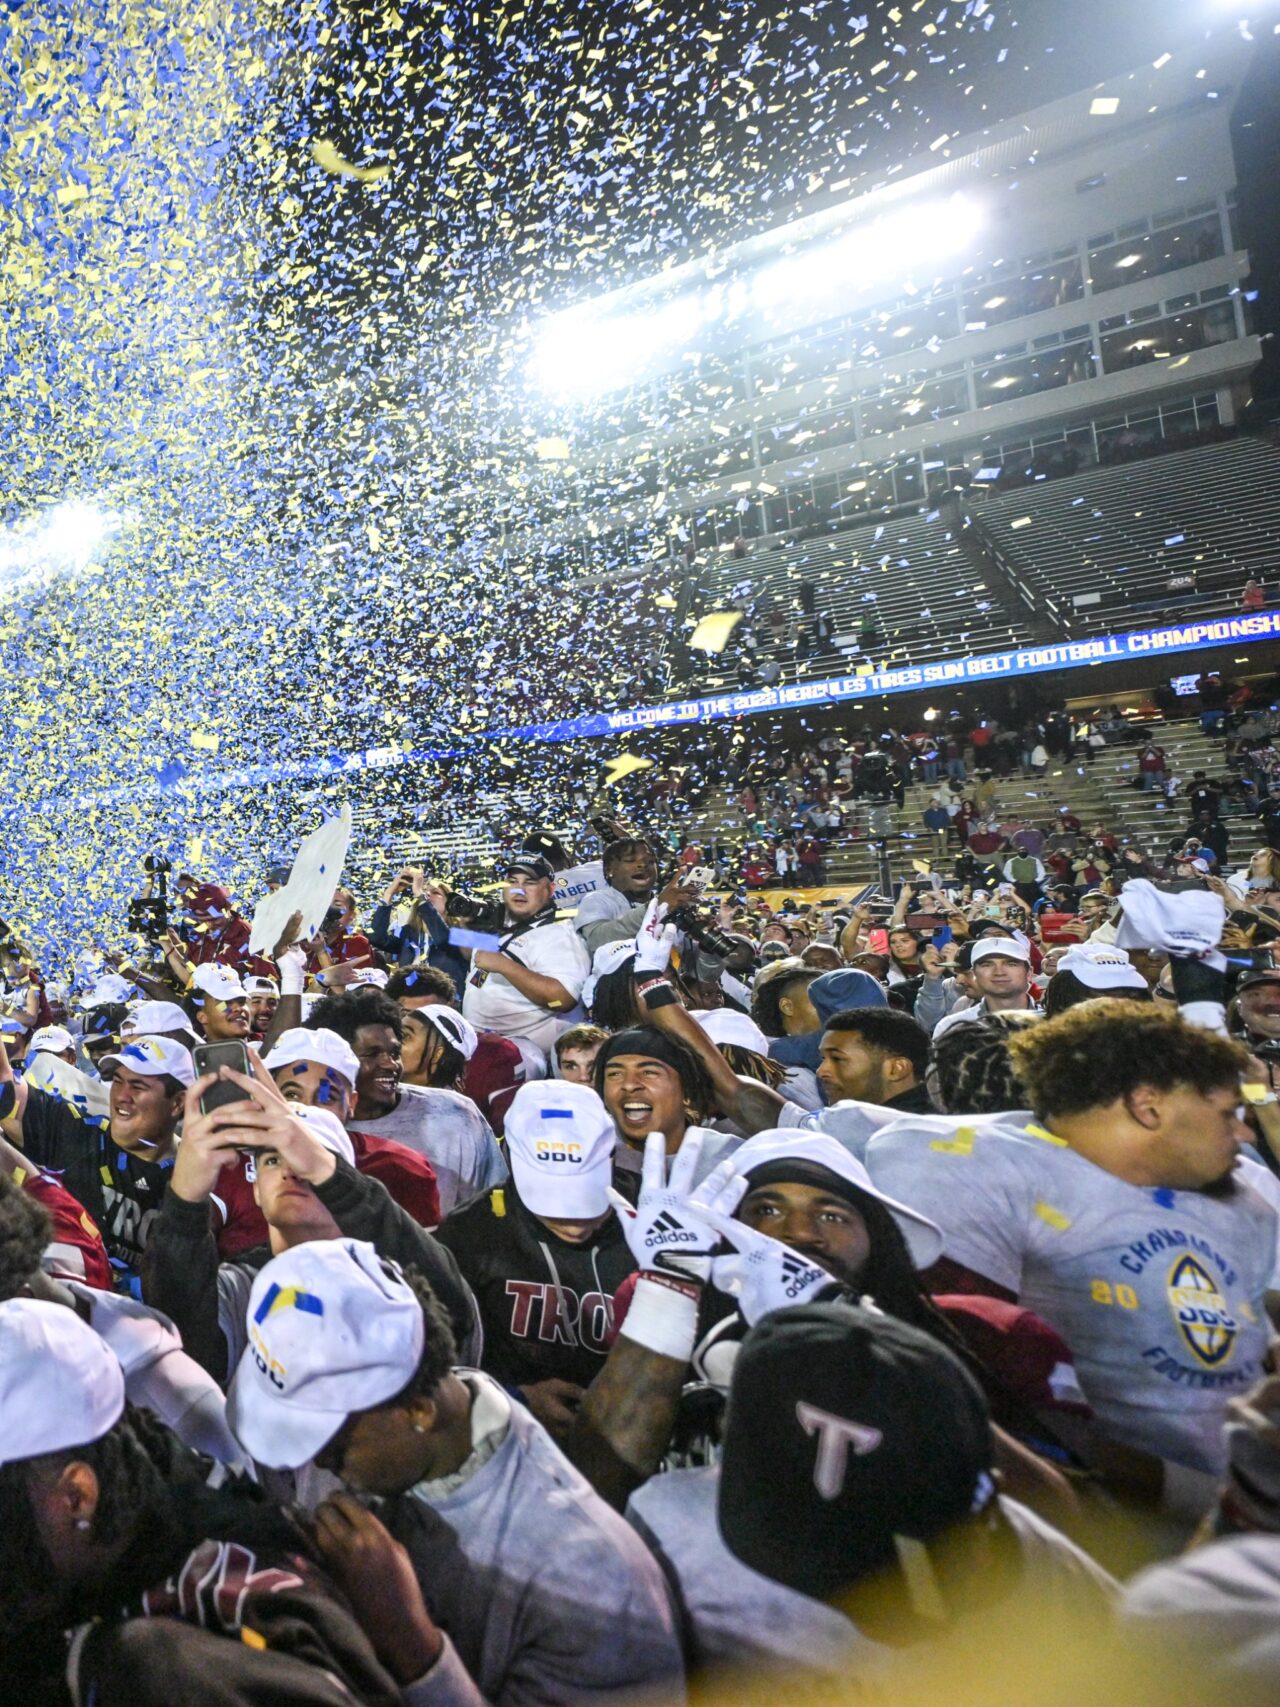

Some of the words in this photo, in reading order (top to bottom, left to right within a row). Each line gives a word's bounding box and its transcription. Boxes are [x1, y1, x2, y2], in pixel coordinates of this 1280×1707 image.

[608, 708, 678, 728] WELCOME
[702, 697, 732, 714] THE
[733, 690, 777, 709] 2022
[779, 677, 867, 703] HERCULES
[868, 667, 923, 691] TIRES
[924, 662, 965, 683] SUN
[967, 653, 1012, 677] BELT
[1017, 638, 1125, 669] FOOTBALL
[568, 879, 597, 897] BELT
[536, 1140, 582, 1163] SBC
[644, 1230, 699, 1248] adidas
[505, 1279, 615, 1355] TRO
[795, 1400, 884, 1500] T
